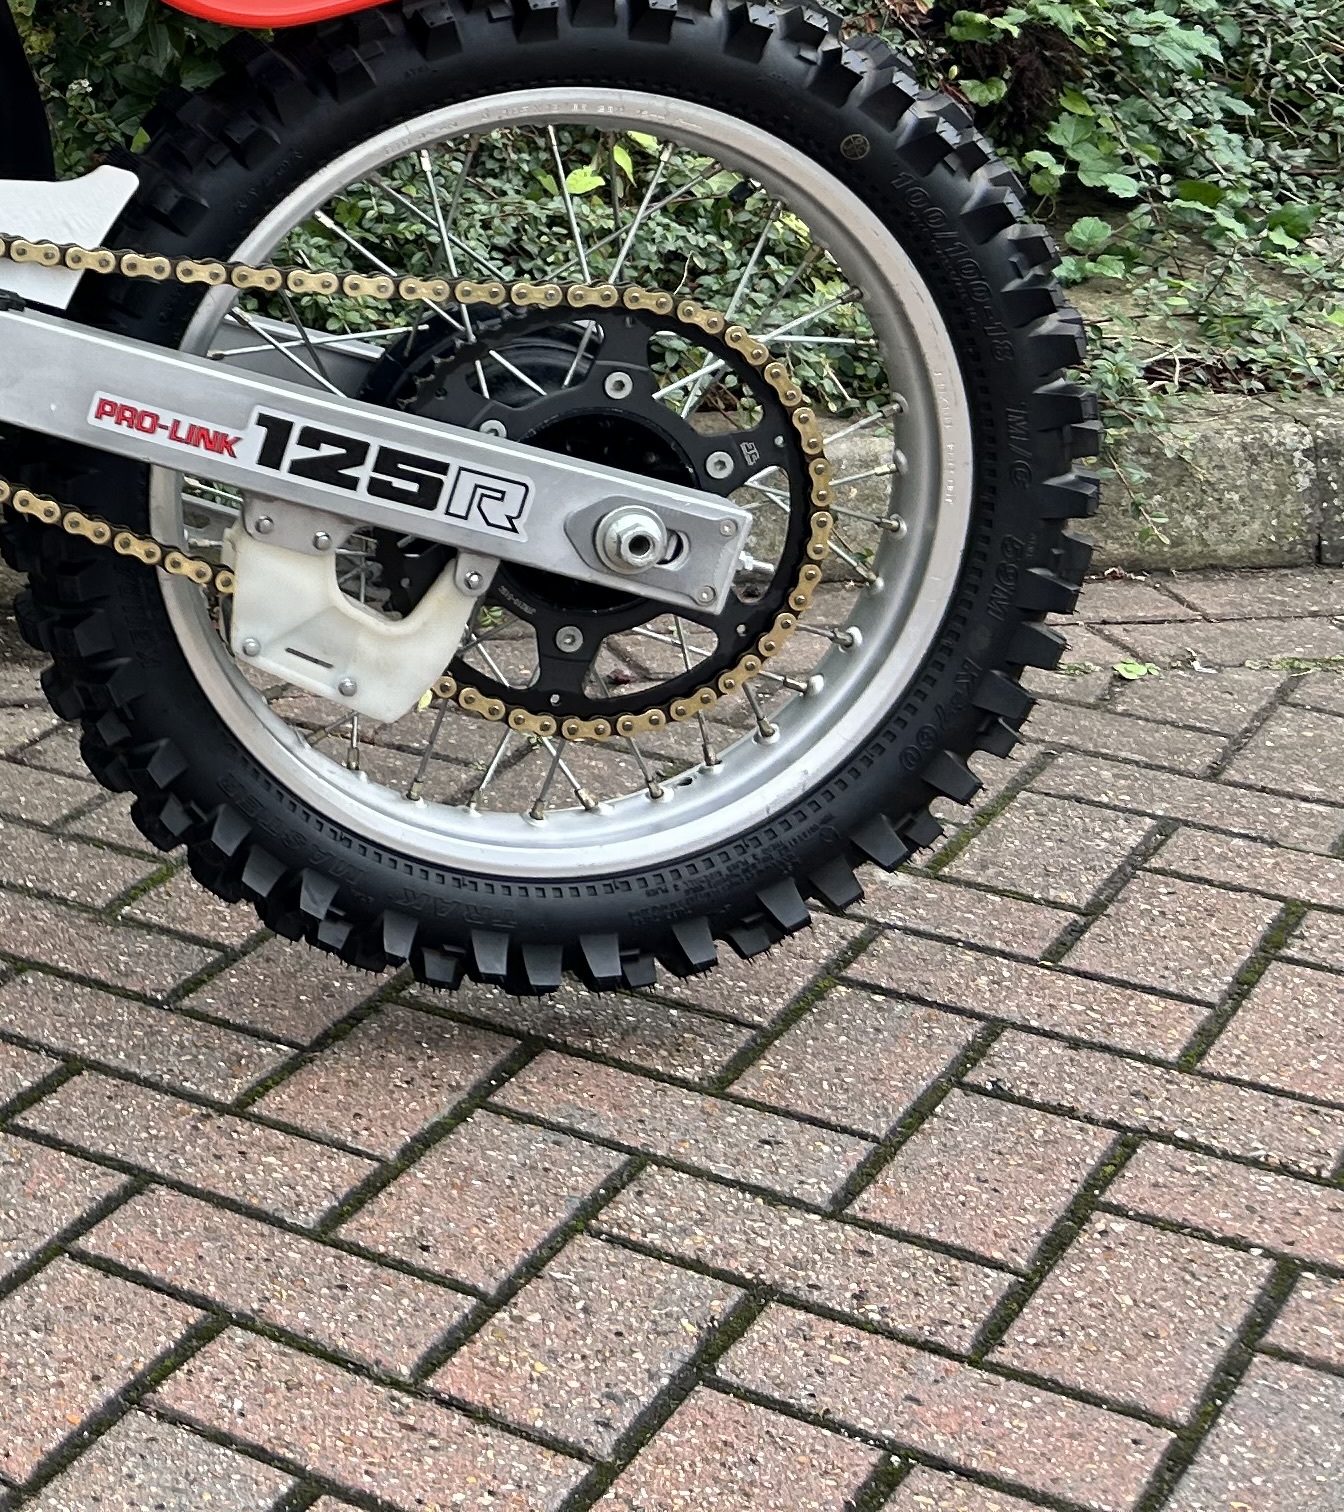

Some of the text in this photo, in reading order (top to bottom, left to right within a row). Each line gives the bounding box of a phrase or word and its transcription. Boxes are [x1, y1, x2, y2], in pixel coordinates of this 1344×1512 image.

[890, 171, 1016, 361] 100/100-18
[94, 397, 531, 535] PRO-LINK 125R
[217, 769, 517, 930] TRAK MASTER
